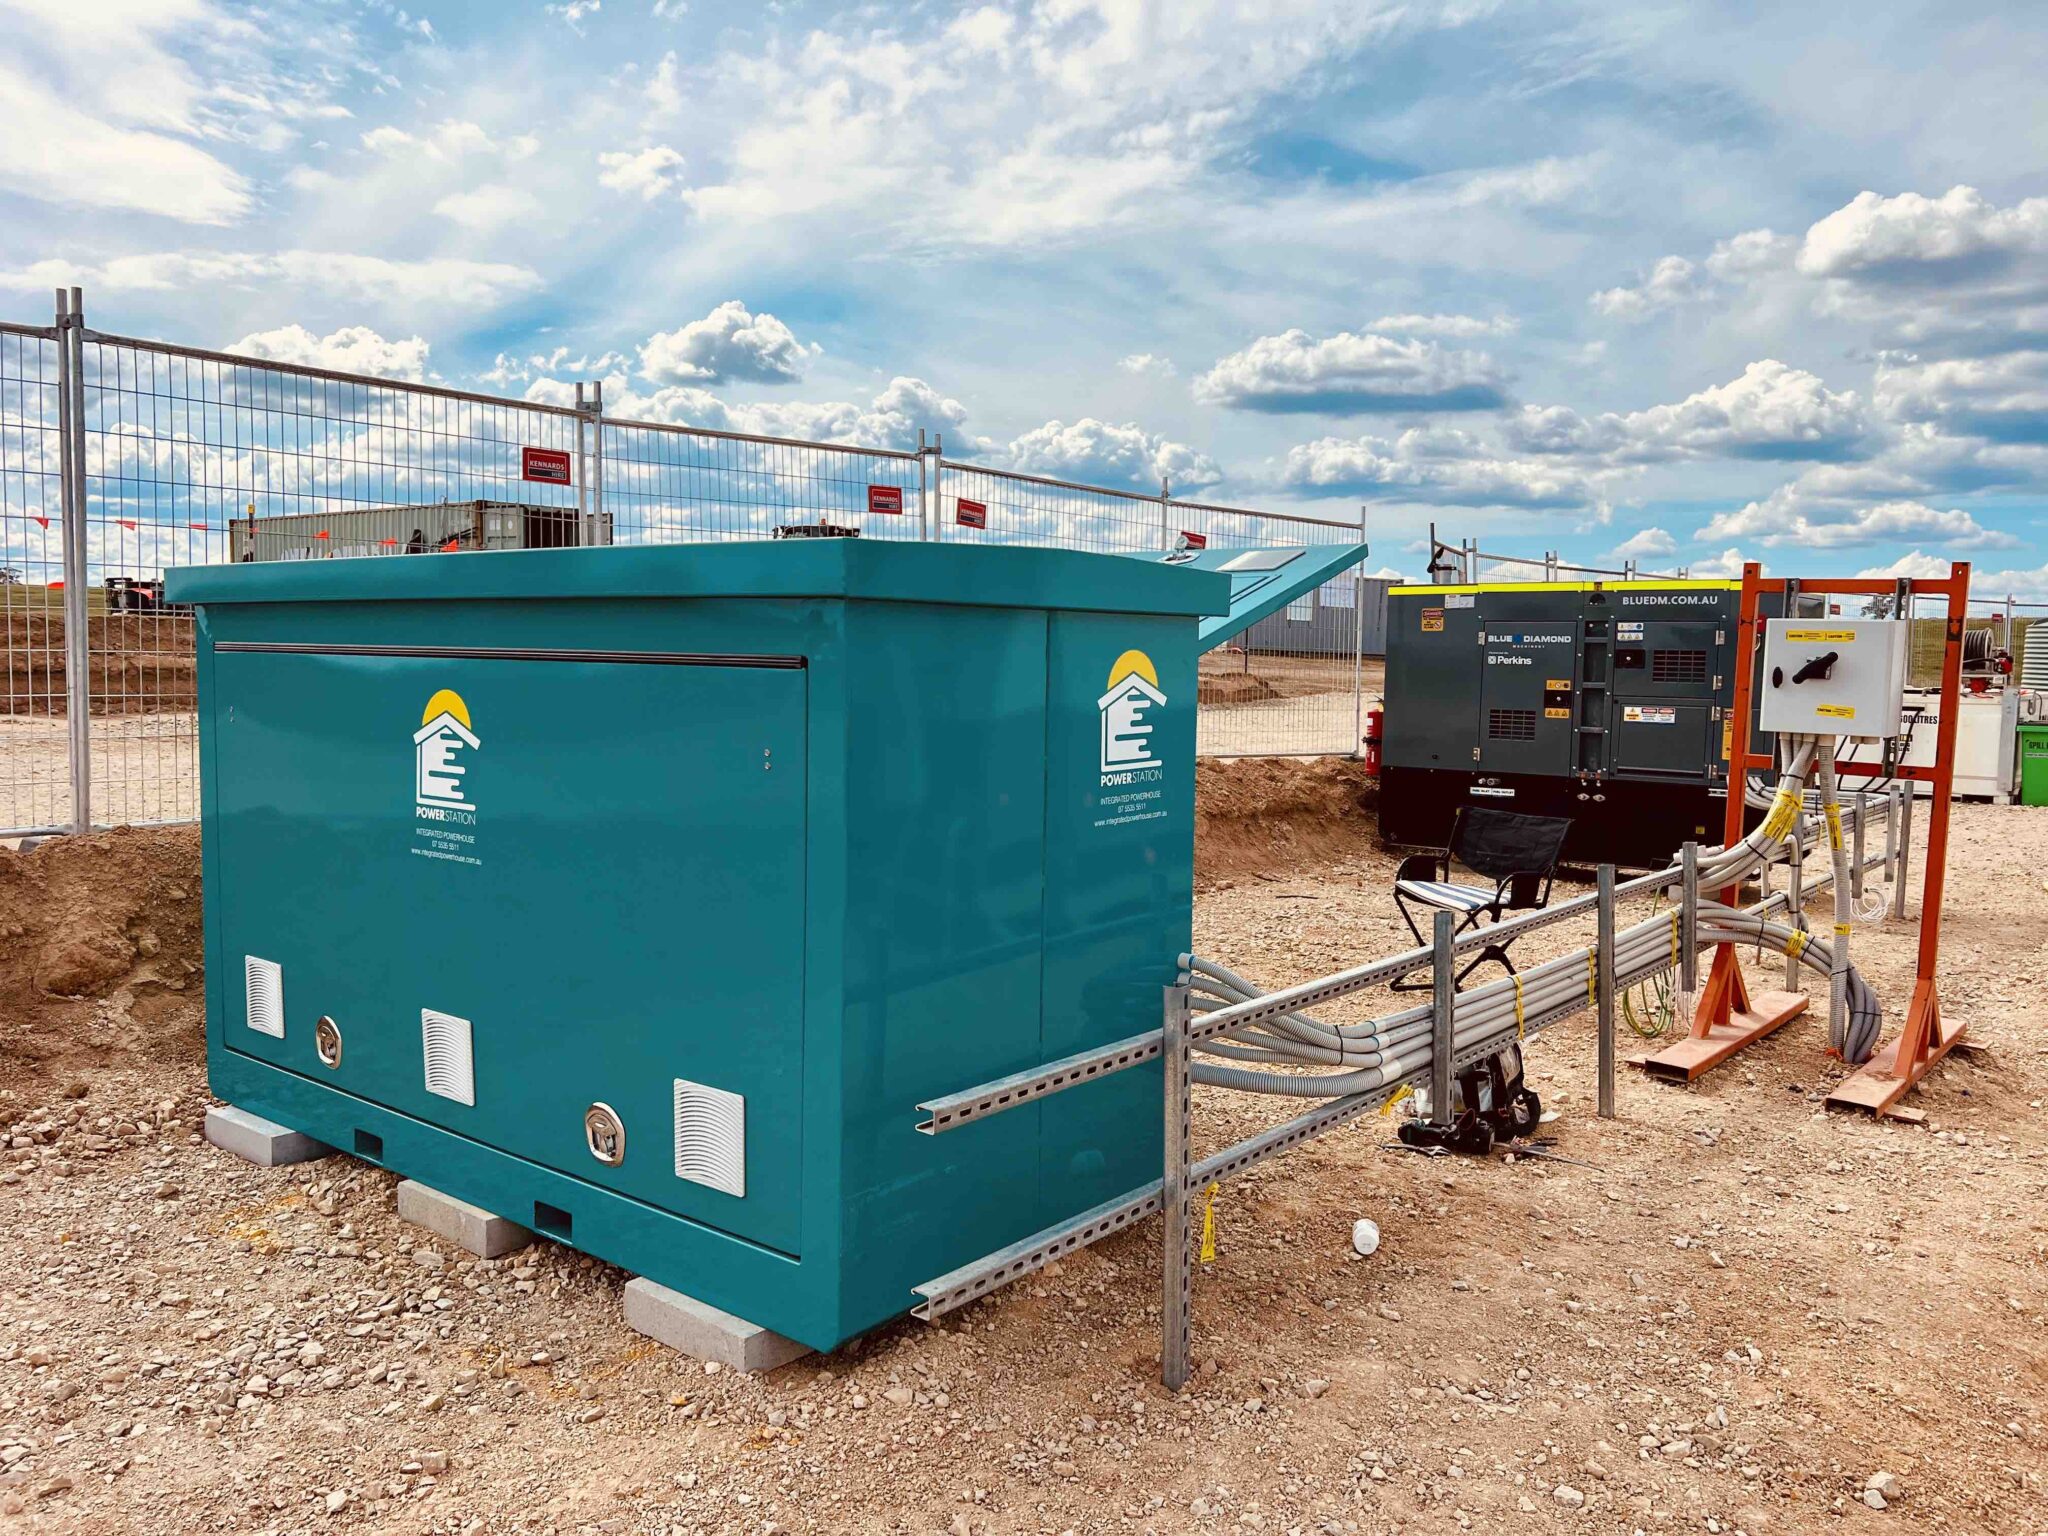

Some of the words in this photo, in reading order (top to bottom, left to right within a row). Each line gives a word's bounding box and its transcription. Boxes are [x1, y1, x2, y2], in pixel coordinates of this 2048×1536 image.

[529, 460, 565, 471] KENNARDS
[873, 495, 898, 503] KENNARDS
[1622, 596, 1718, 605] BLUEDM.COM.AU
[1488, 635, 1512, 643] BLUE
[1523, 635, 1572, 643] DIAMOND
[1497, 656, 1532, 665] Perkins
[1101, 769, 1163, 787] POWERSTATION
[1101, 794, 1130, 805] INTEGRATED
[1130, 790, 1161, 801] POWERHOUSE
[416, 806, 476, 825] POWERSTATION
[1094, 811, 1167, 827] www.integratedpowerhouse.com.au
[416, 828, 443, 838] INTEGRATED
[443, 832, 475, 843] POWERHOUSE
